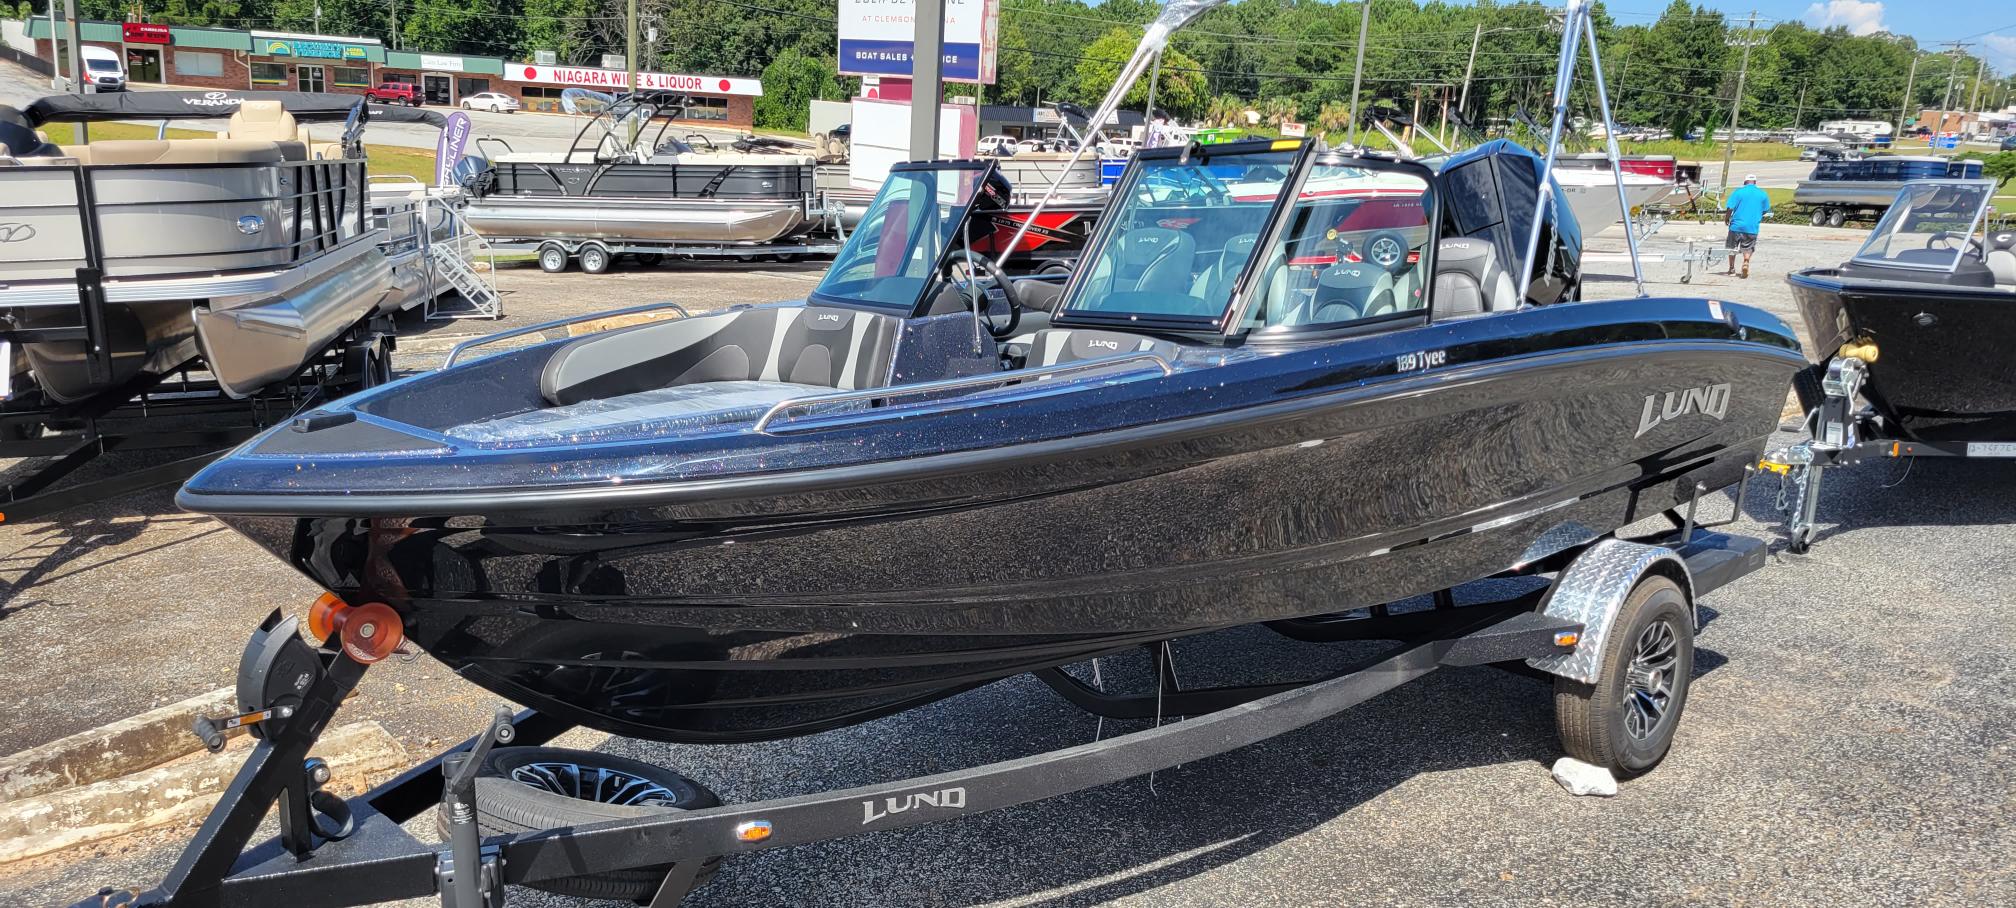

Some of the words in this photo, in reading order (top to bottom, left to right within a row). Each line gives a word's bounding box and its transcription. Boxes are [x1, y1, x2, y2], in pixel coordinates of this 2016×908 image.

[856, 52, 878, 60] BOAT
[880, 53, 908, 61] SALES
[553, 70, 608, 84] NIAGARA
[611, 73, 641, 87] WIE
[646, 75, 655, 87] &
[659, 76, 702, 90] LIQUOR
[1439, 242, 1470, 250] LUND
[817, 313, 839, 322] LUND
[1088, 338, 1119, 351] LUND
[1396, 353, 1416, 373] 189
[1416, 350, 1446, 370] Tyee
[1634, 382, 1732, 439] LUND
[862, 786, 966, 825] LUND
